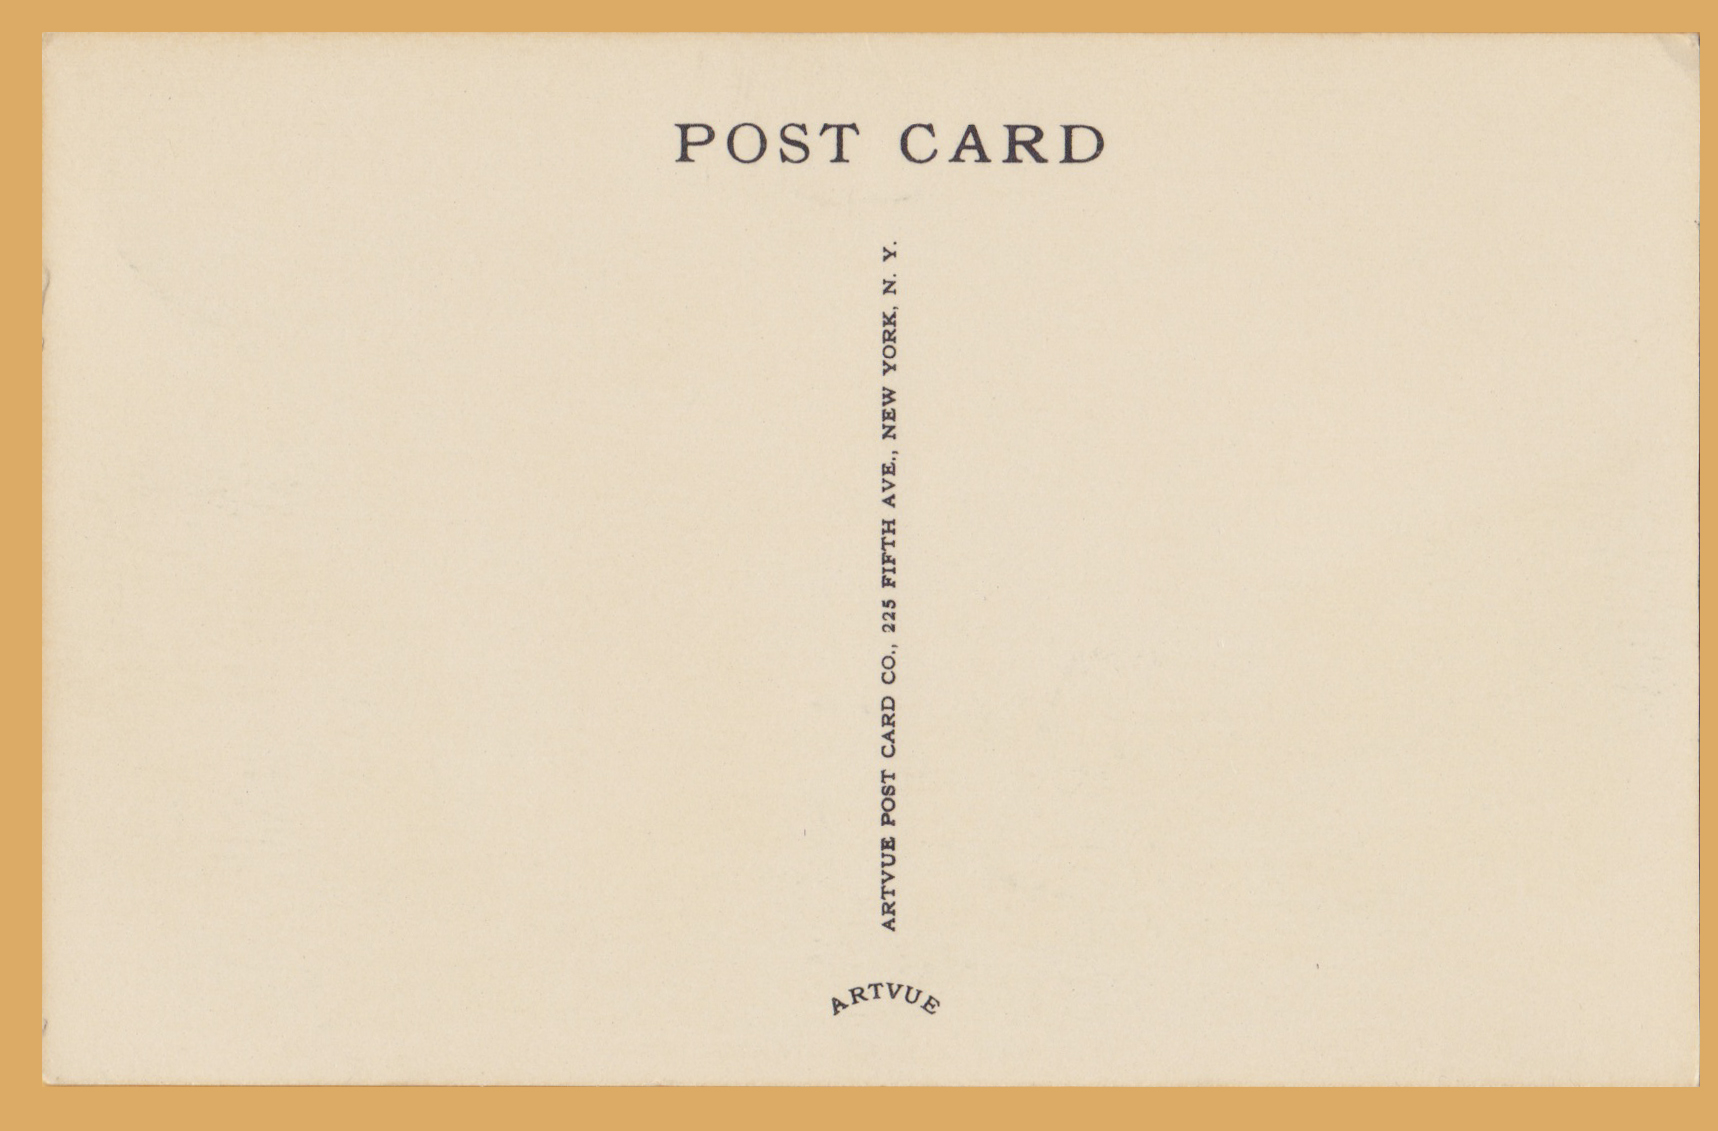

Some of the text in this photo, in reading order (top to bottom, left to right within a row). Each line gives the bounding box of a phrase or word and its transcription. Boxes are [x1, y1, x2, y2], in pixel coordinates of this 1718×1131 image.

[674, 122, 1105, 164] POST CARD
[880, 240, 899, 932] ARTVUE POST CARD CO., 225 FIFTH AVE., NEW YORK, N. Y.
[830, 982, 941, 1017] ARTVUE
